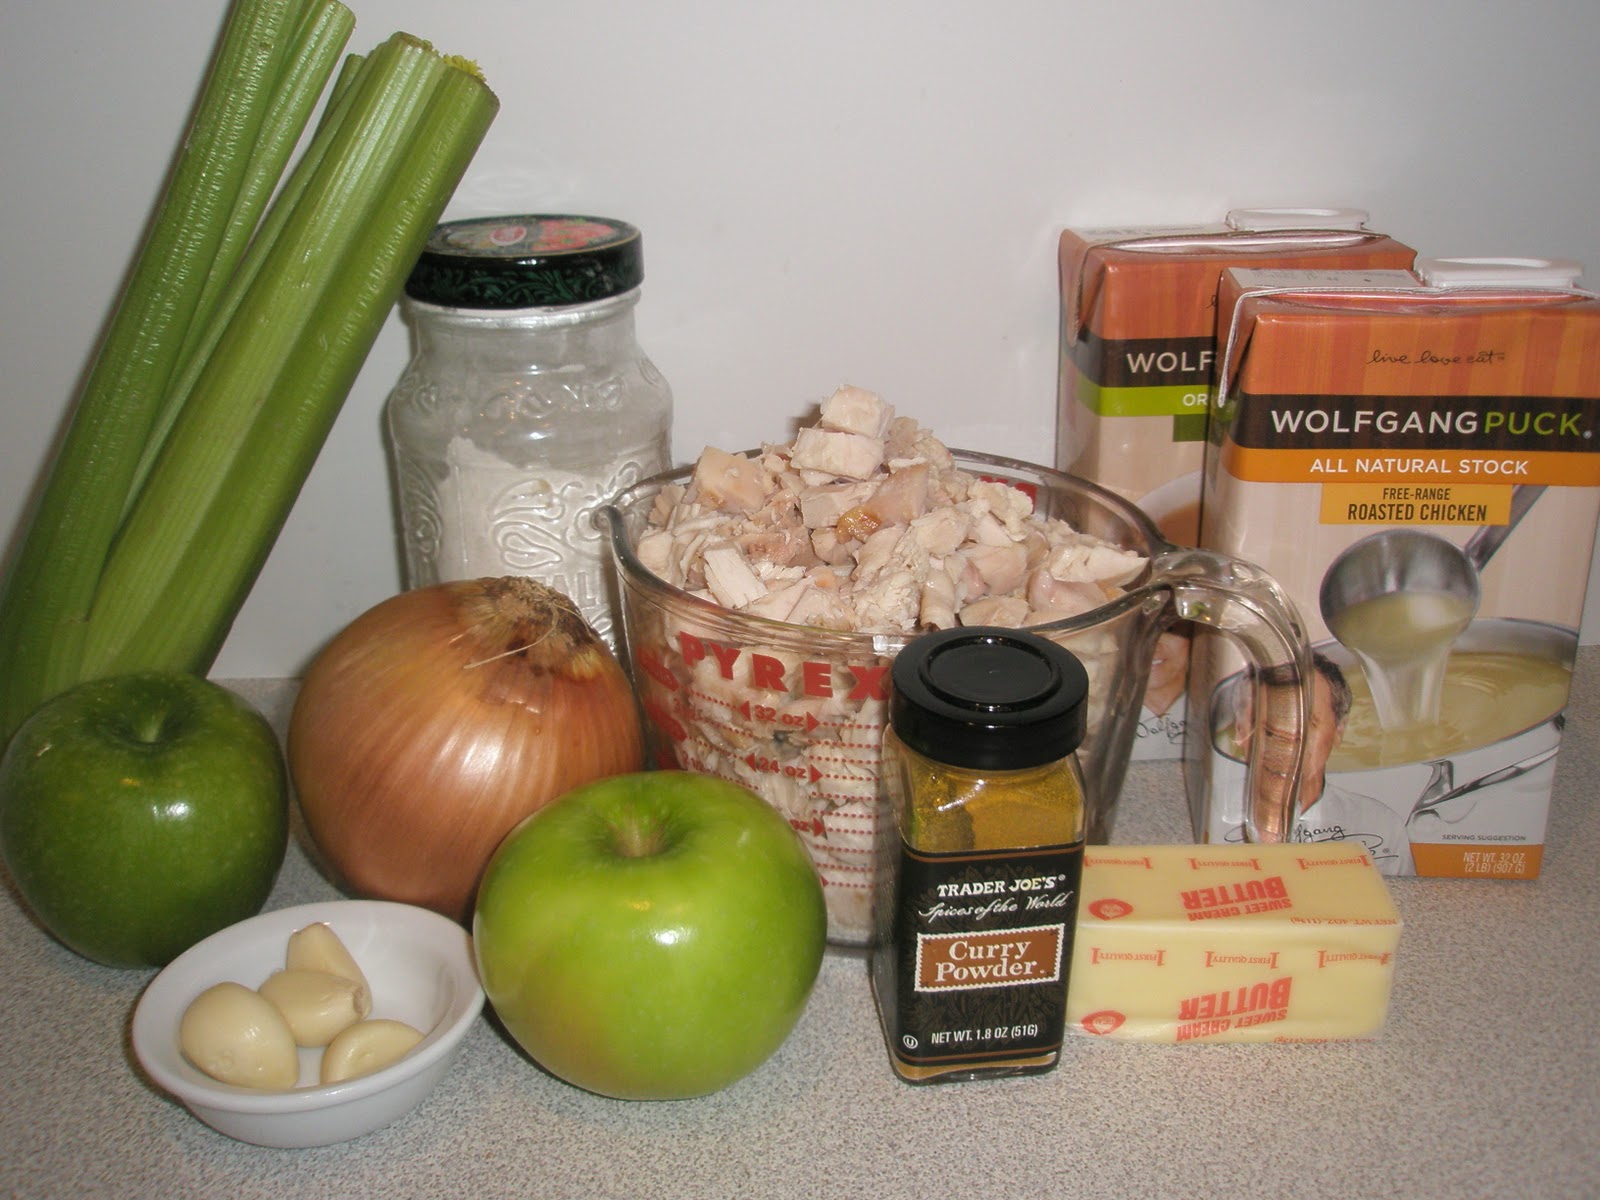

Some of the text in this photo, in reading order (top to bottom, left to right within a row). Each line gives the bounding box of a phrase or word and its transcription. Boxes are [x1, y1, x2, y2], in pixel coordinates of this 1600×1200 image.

[1366, 349, 1493, 366] live love eat
[1271, 409, 1478, 435] WOLFGANG
[1310, 458, 1529, 475] ALL NATURAL STOCK
[1382, 487, 1451, 501] FREE-RANGE
[1347, 503, 1487, 522] ROASTED CHICKEN
[679, 630, 890, 702] PYREX
[754, 704, 777, 724] 32
[757, 758, 781, 774] 24
[1463, 852, 1480, 862] NET
[1499, 852, 1511, 863] 32
[937, 880, 1006, 897] TRADER
[1180, 876, 1288, 910] BUTTER
[918, 902, 974, 923] Spices
[993, 898, 1018, 914] the
[1026, 891, 1074, 910] World
[1187, 898, 1292, 922] SWEET CREAM
[948, 939, 1032, 961] Curry
[935, 956, 1038, 983] Powder
[1178, 976, 1293, 1021] BUTTER
[931, 1024, 1038, 1044] NET WT. 1.8 OZ (51G)
[1176, 1009, 1288, 1042] SWEET CREAM
